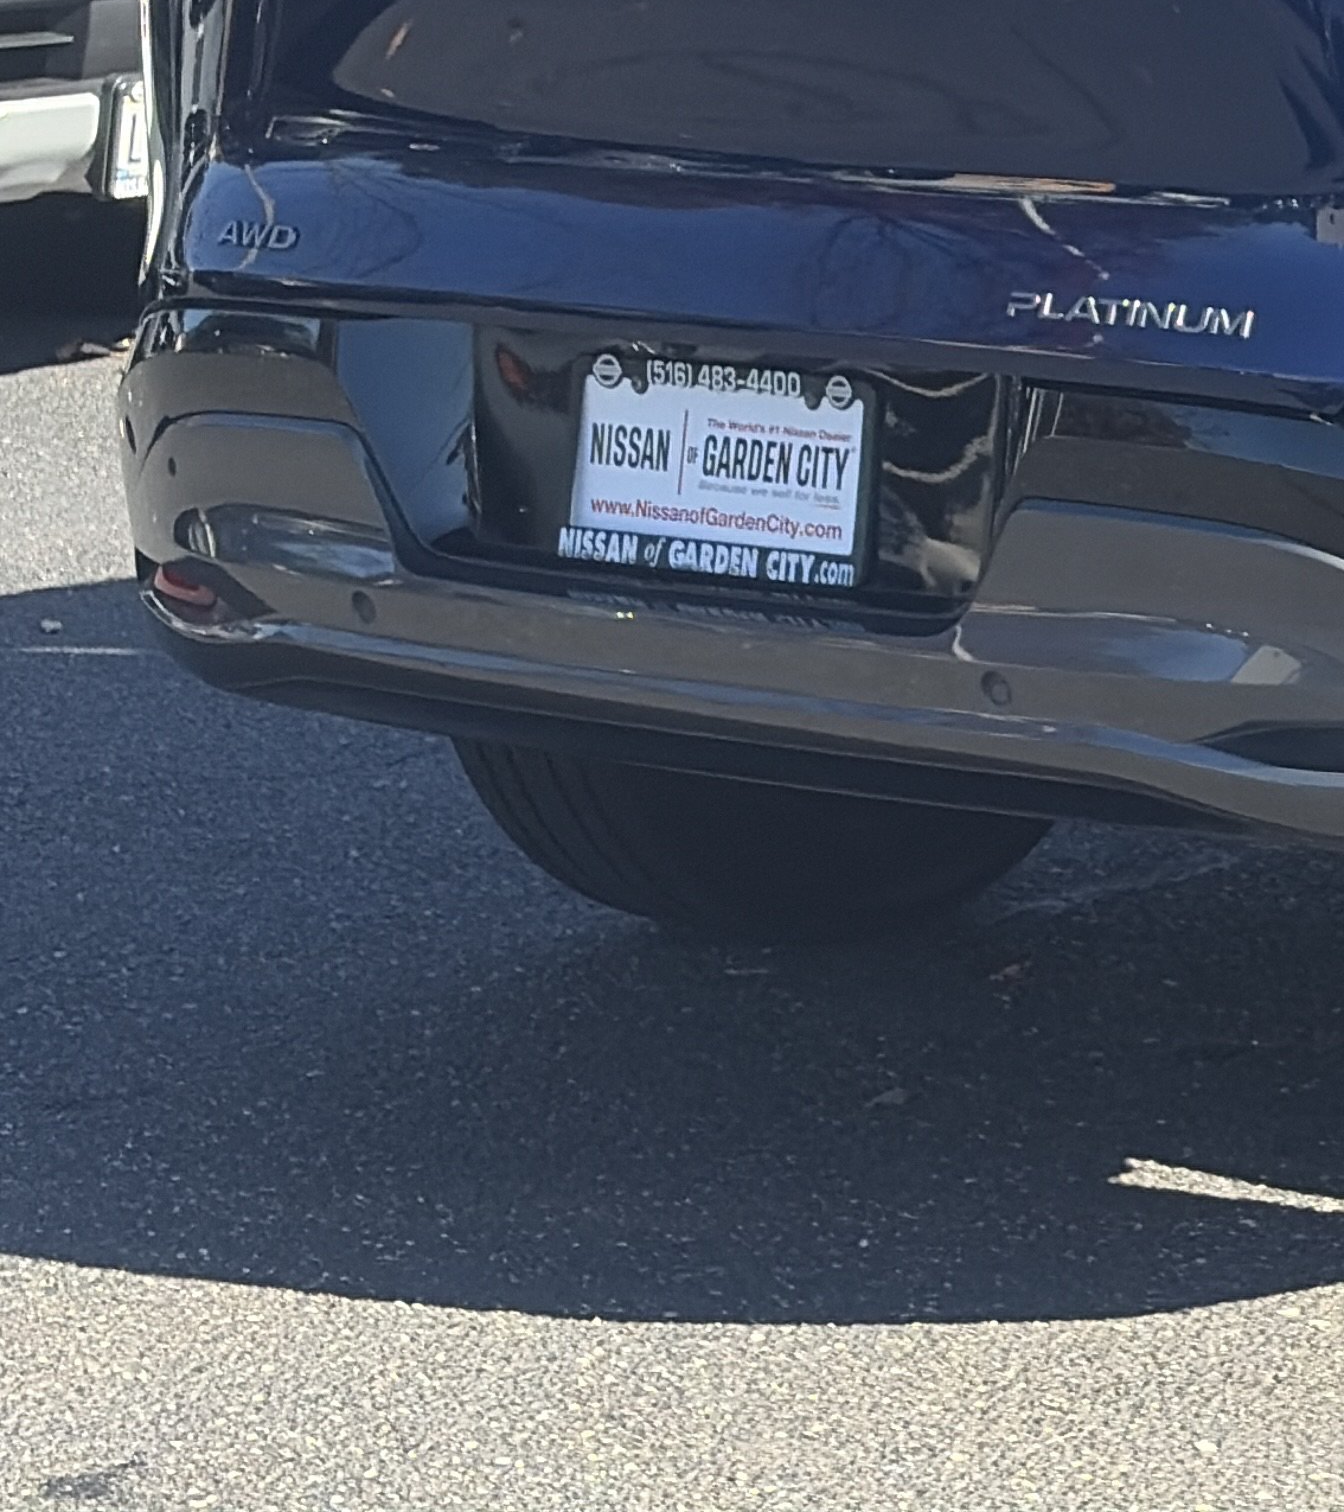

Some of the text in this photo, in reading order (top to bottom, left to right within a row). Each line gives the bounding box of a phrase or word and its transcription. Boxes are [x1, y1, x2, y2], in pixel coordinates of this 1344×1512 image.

[217, 220, 299, 249] AWD
[1006, 291, 1255, 339] PLATINUM
[647, 359, 801, 397] (516) 483-4400
[590, 422, 670, 472] NISSAN
[687, 434, 850, 491] OF GARDEN CITY
[591, 498, 842, 540] www.NissanofGardenCity.com
[558, 527, 855, 587] NISSAN of GARDEN CITY.com
